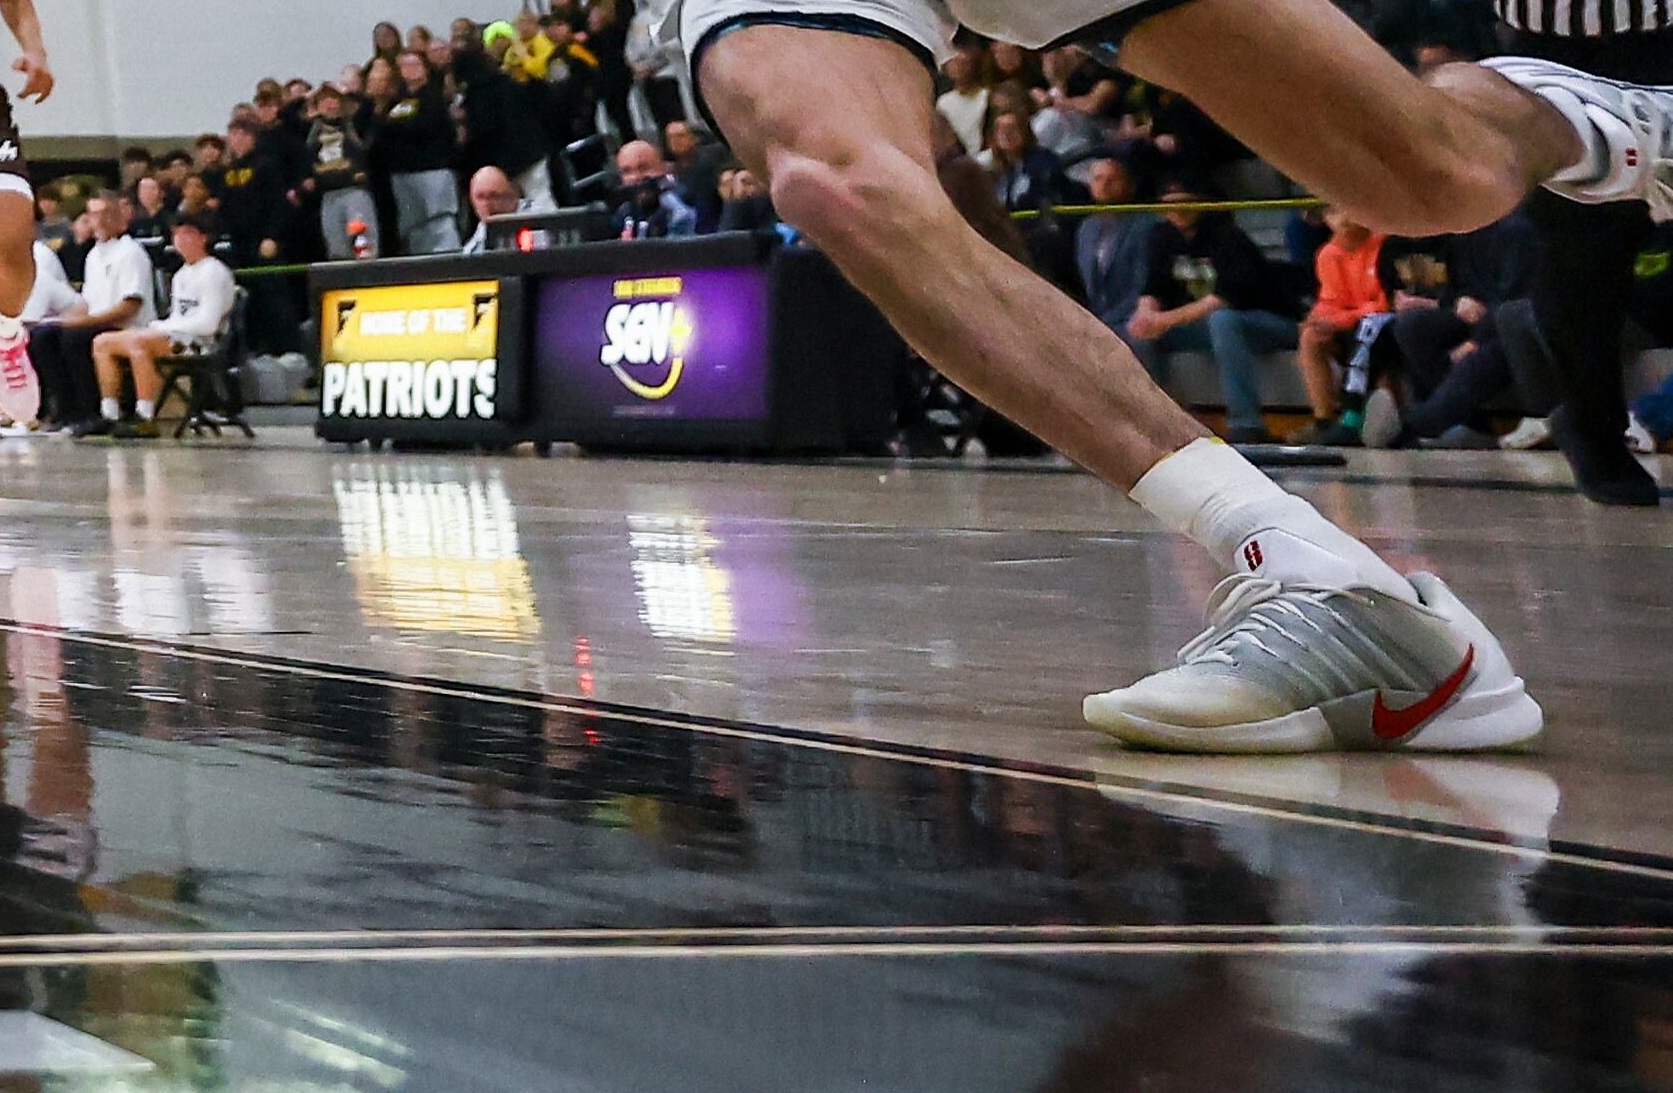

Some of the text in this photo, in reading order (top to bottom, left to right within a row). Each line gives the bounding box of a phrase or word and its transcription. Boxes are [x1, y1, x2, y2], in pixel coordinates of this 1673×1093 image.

[359, 307, 468, 337] HOME OF THE
[321, 358, 498, 420] PATRIOTS
